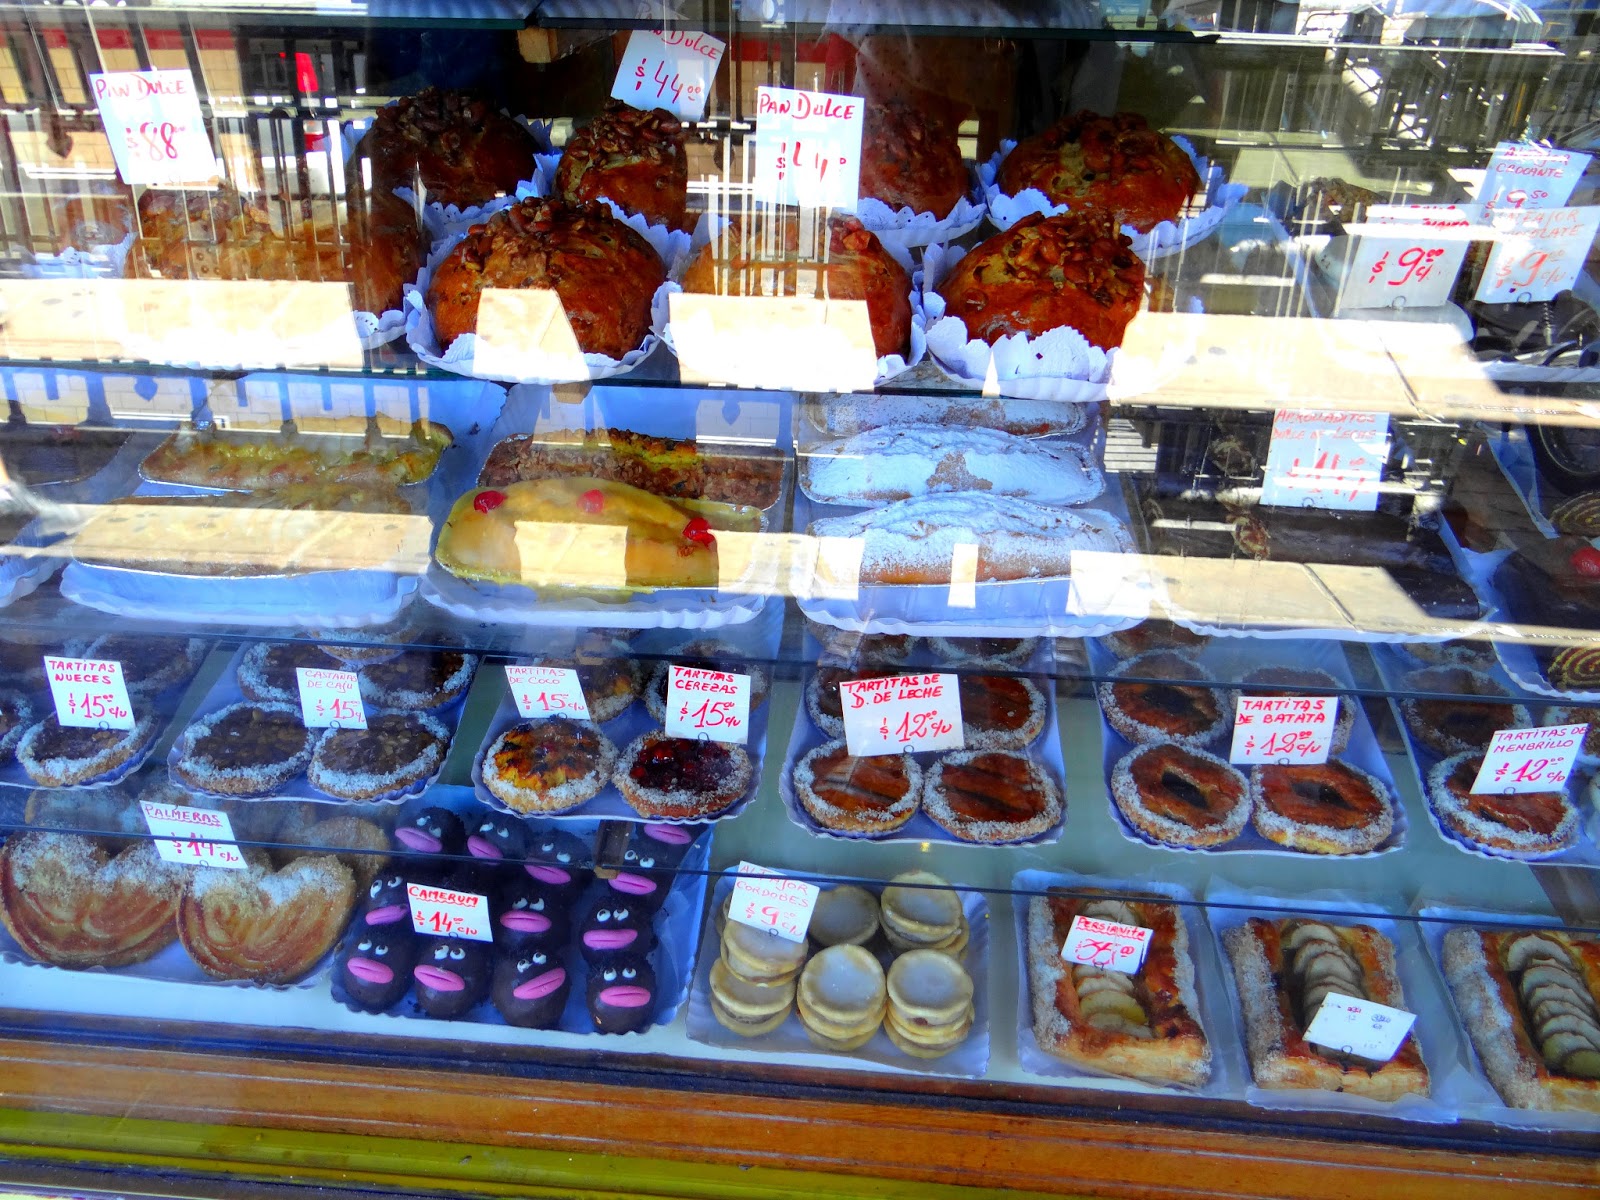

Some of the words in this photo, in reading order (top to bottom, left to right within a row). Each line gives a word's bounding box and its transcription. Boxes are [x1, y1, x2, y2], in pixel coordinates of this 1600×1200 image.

[661, 29, 722, 60] DULCE
[760, 93, 791, 114] PAN
[792, 93, 855, 119] DULCE
[49, 660, 116, 673] TARTITAS
[507, 667, 566, 677] TARTITAS
[674, 666, 734, 683] TARTITAS
[55, 673, 112, 685] NUECES
[307, 680, 323, 689] DE
[509, 677, 523, 685] DE
[528, 676, 560, 685] COCO
[675, 679, 738, 695] CEREZAS
[842, 676, 919, 694] TARTITAS
[923, 673, 941, 685] DE
[873, 691, 891, 704] DE
[898, 685, 943, 700] LECHE
[1242, 698, 1325, 712] TARTITAS
[1262, 713, 1325, 724] BATATA
[1494, 728, 1568, 743] TARTITAS
[1571, 726, 1588, 736] DE
[145, 804, 221, 823] PALMERAS
[408, 886, 479, 905] CAMERUM
[736, 880, 809, 908] CORDOBES
